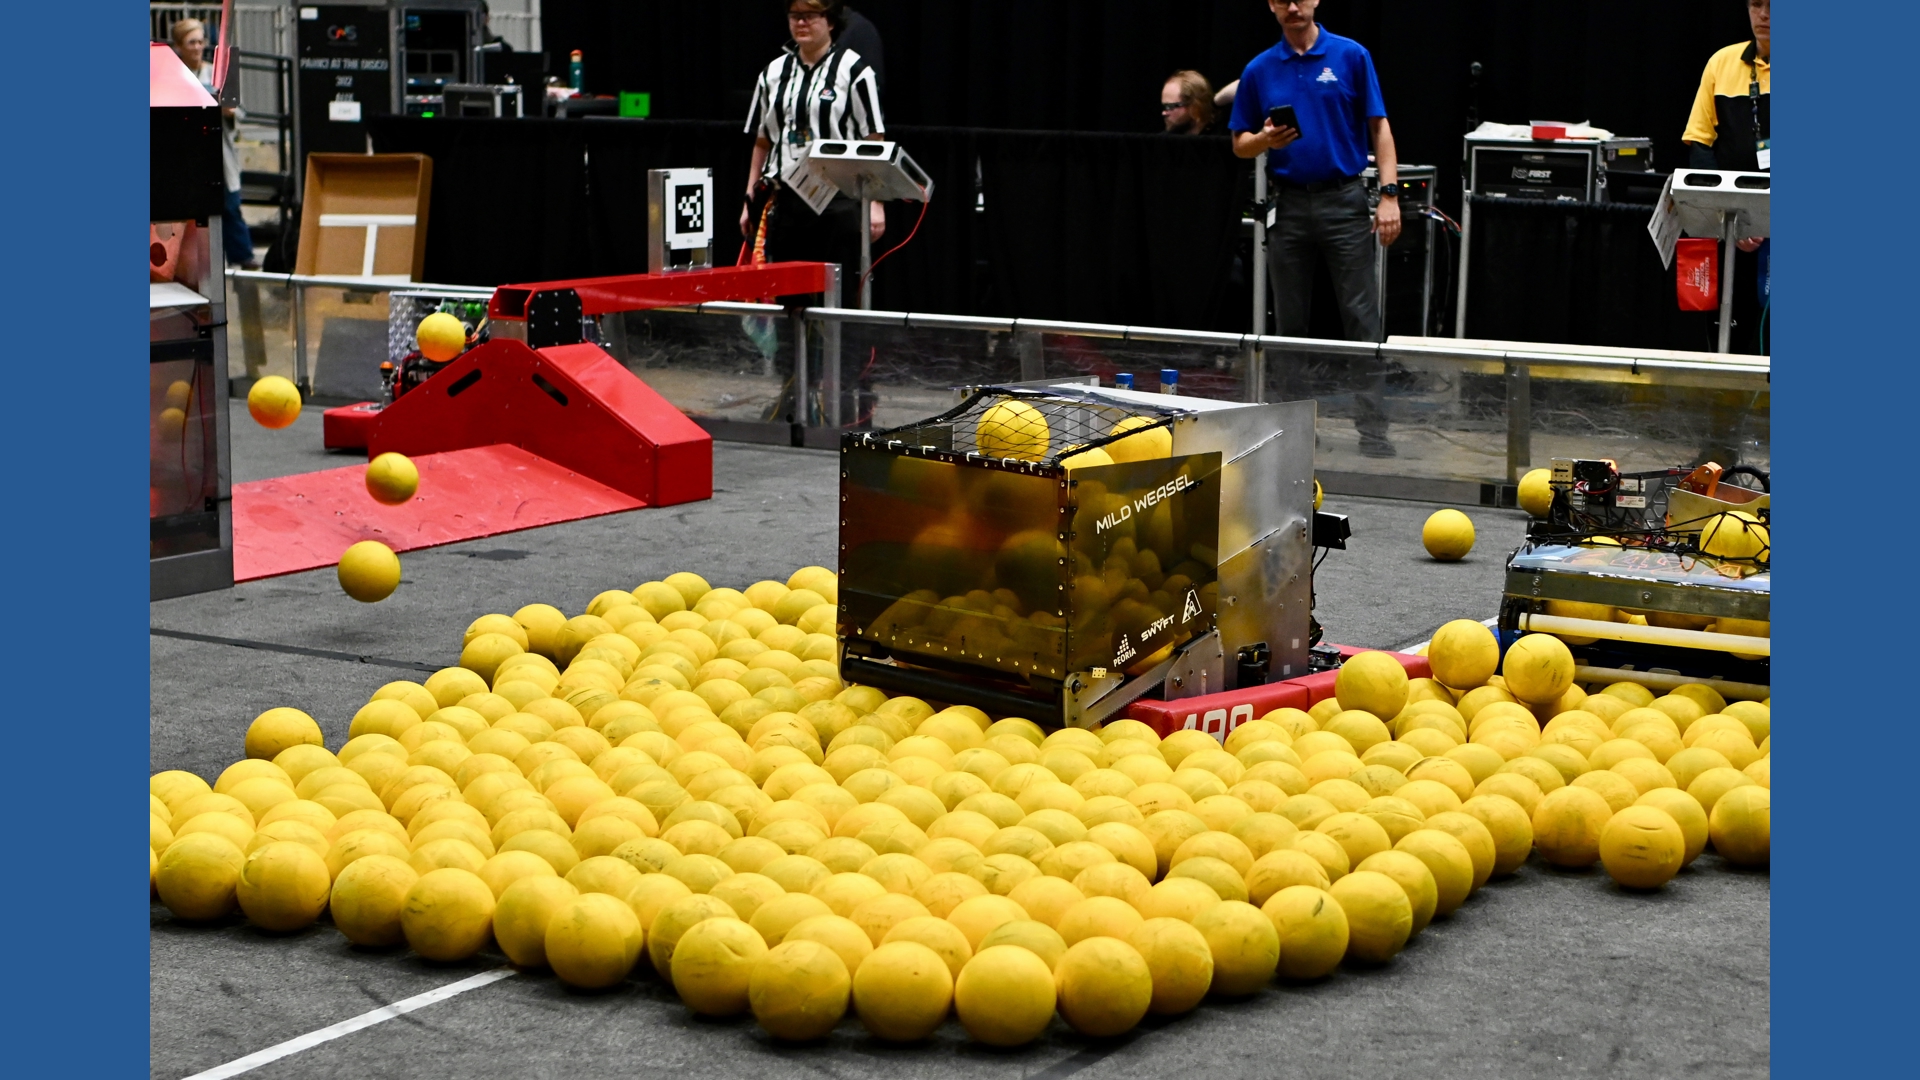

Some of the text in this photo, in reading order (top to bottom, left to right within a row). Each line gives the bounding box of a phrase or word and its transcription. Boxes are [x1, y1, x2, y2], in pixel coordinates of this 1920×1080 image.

[1528, 170, 1552, 178] FIRST
[1096, 474, 1194, 534] MILD WEASEL
[1141, 614, 1175, 642] SWYFT
[1113, 647, 1137, 667] PEORIA
